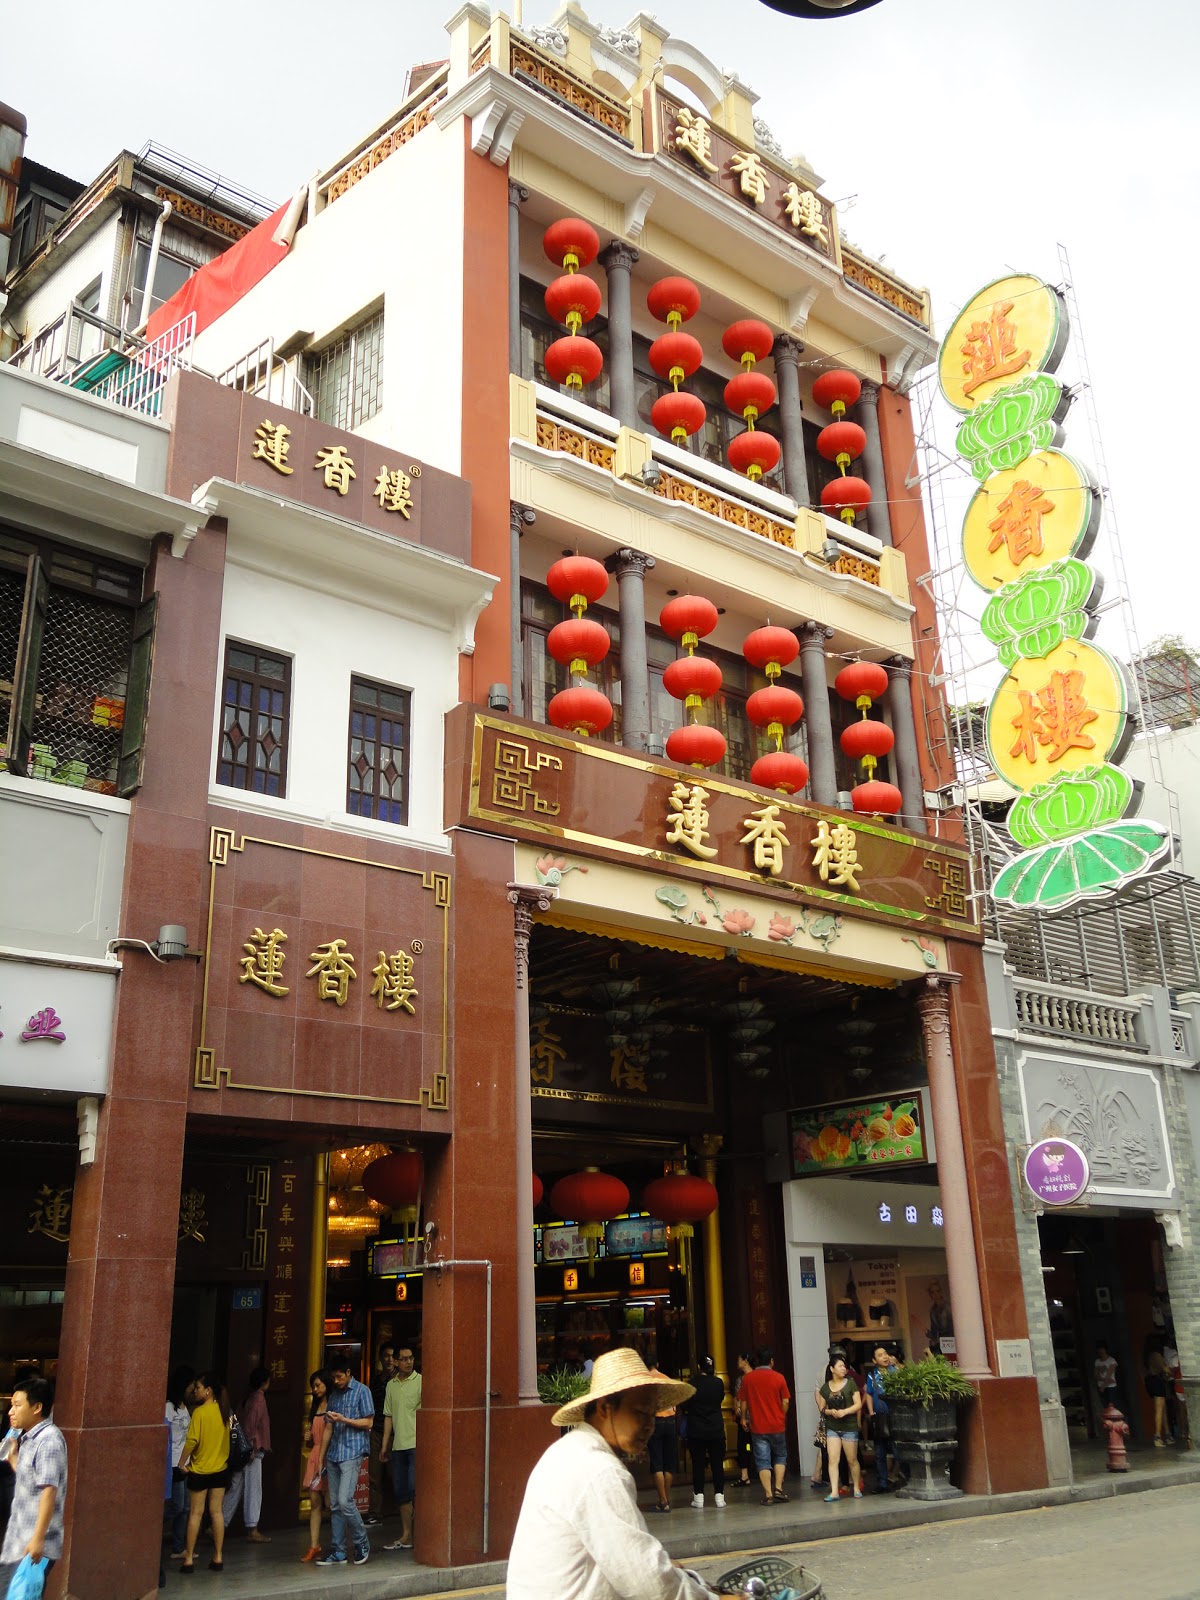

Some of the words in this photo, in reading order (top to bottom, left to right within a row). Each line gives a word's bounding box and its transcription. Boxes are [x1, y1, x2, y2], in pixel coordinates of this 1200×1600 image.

[675, 107, 829, 246] 蓮香樓
[665, 782, 864, 891] 蓮香樓
[867, 1262, 895, 1271] Tokyo
[240, 1296, 253, 1307] 65
